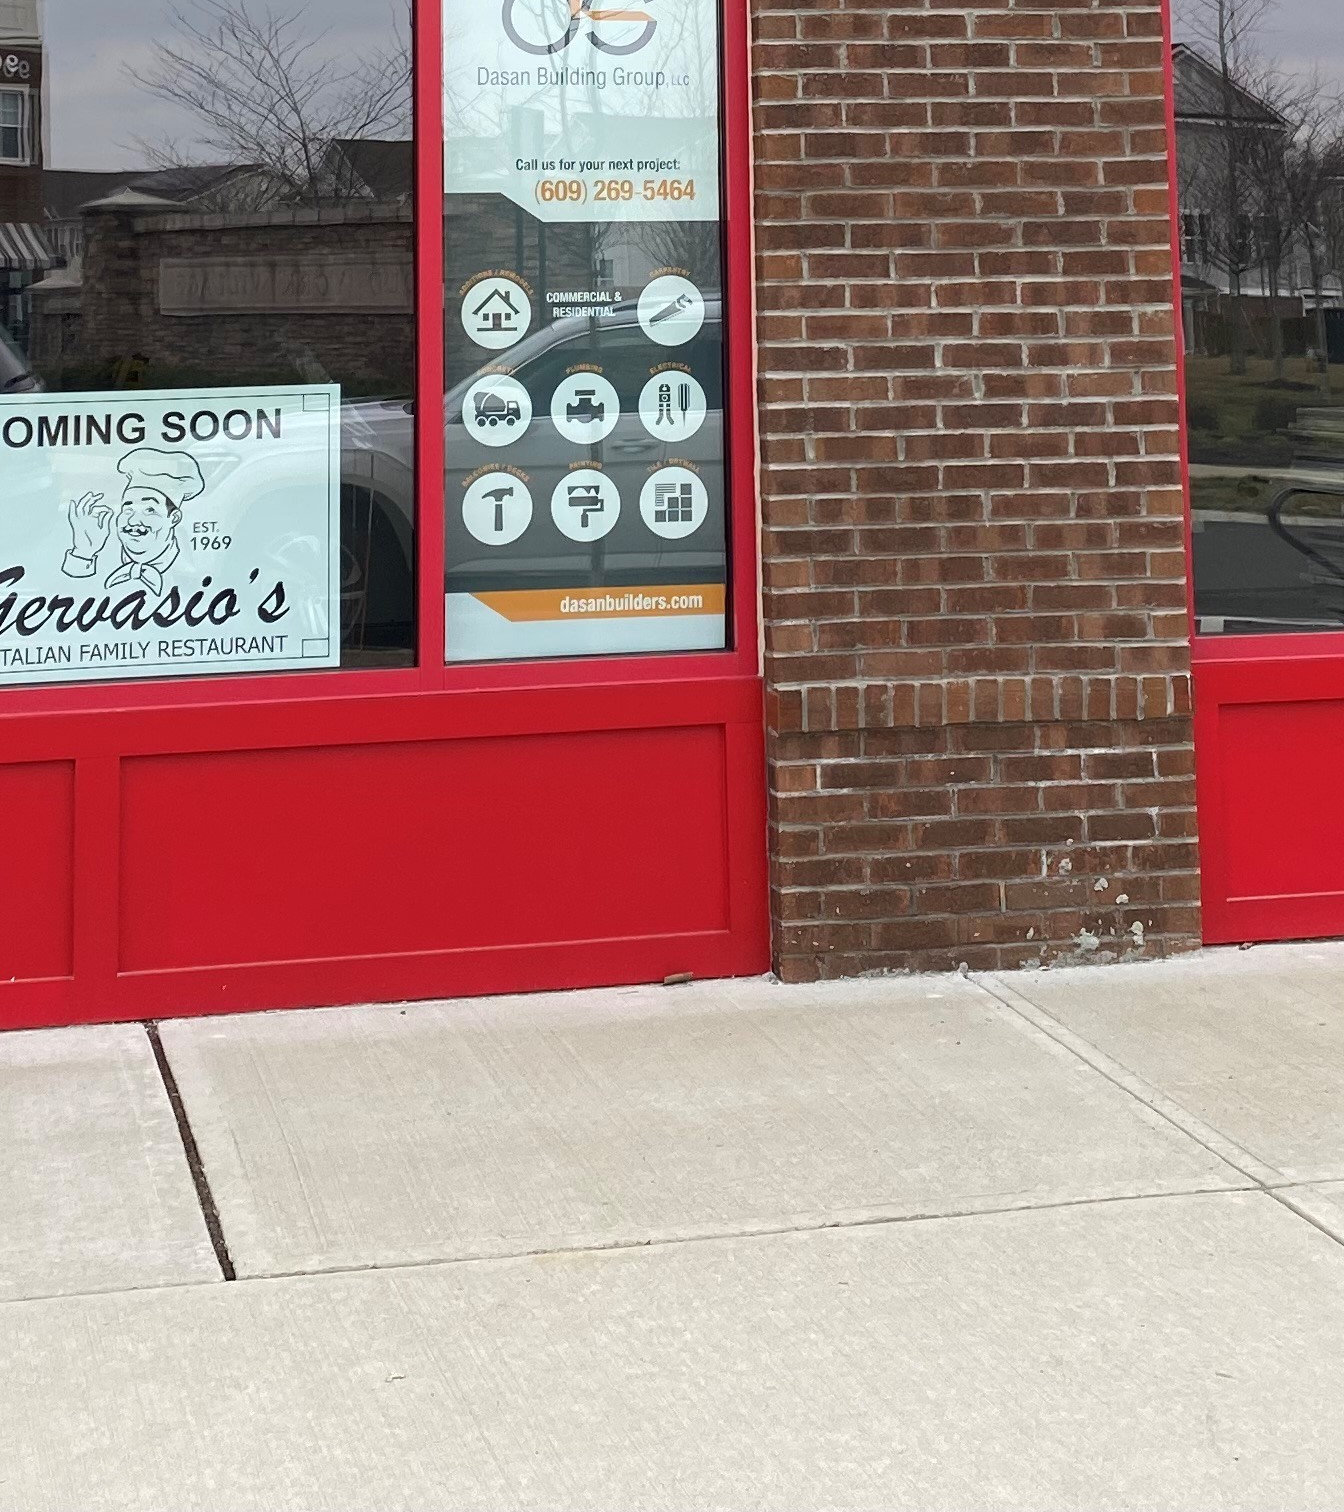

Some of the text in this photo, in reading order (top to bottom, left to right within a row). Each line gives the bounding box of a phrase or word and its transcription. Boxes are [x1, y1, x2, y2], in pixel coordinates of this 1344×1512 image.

[477, 66, 531, 86] Dasan
[537, 66, 606, 89] Building
[515, 157, 681, 173] Call us for your next project:
[534, 178, 696, 205] (609) 269-5464
[546, 291, 623, 303] COMMERCIAL &
[552, 306, 616, 318] RESIDENTIAL
[161, 408, 282, 442] SOON
[193, 521, 220, 533] EST.
[191, 536, 232, 551] 1969
[560, 594, 703, 613] dasanbuilders.com
[80, 641, 150, 662] FAMILY
[157, 635, 289, 658] RESTAURANT
